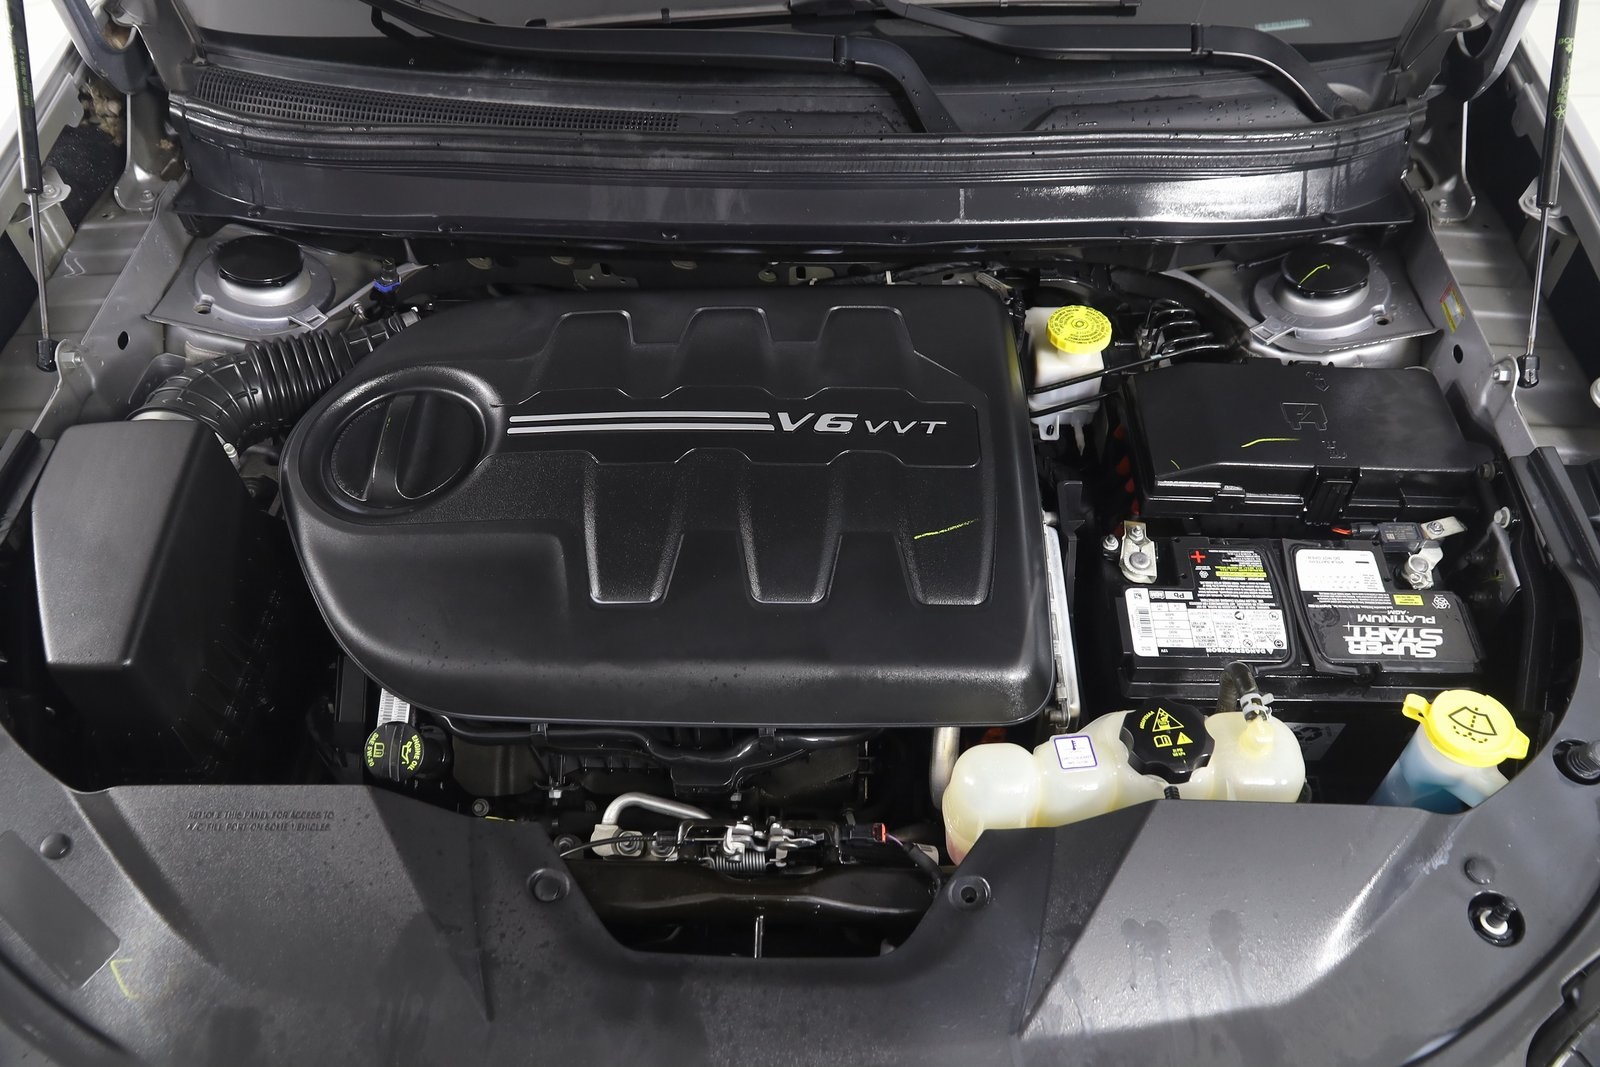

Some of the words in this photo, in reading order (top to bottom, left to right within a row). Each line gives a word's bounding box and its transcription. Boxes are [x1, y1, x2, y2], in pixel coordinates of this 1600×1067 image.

[777, 412, 859, 432] V6
[865, 420, 947, 434] VVT
[1357, 613, 1436, 624] PLATINUM
[1347, 626, 1443, 646] START
[1348, 640, 1437, 658] SUPER
[412, 734, 421, 760] ENGINE
[407, 760, 418, 771] OIL
[271, 810, 288, 819] FOR
[290, 810, 321, 819] ACCESS
[323, 810, 335, 819] TO
